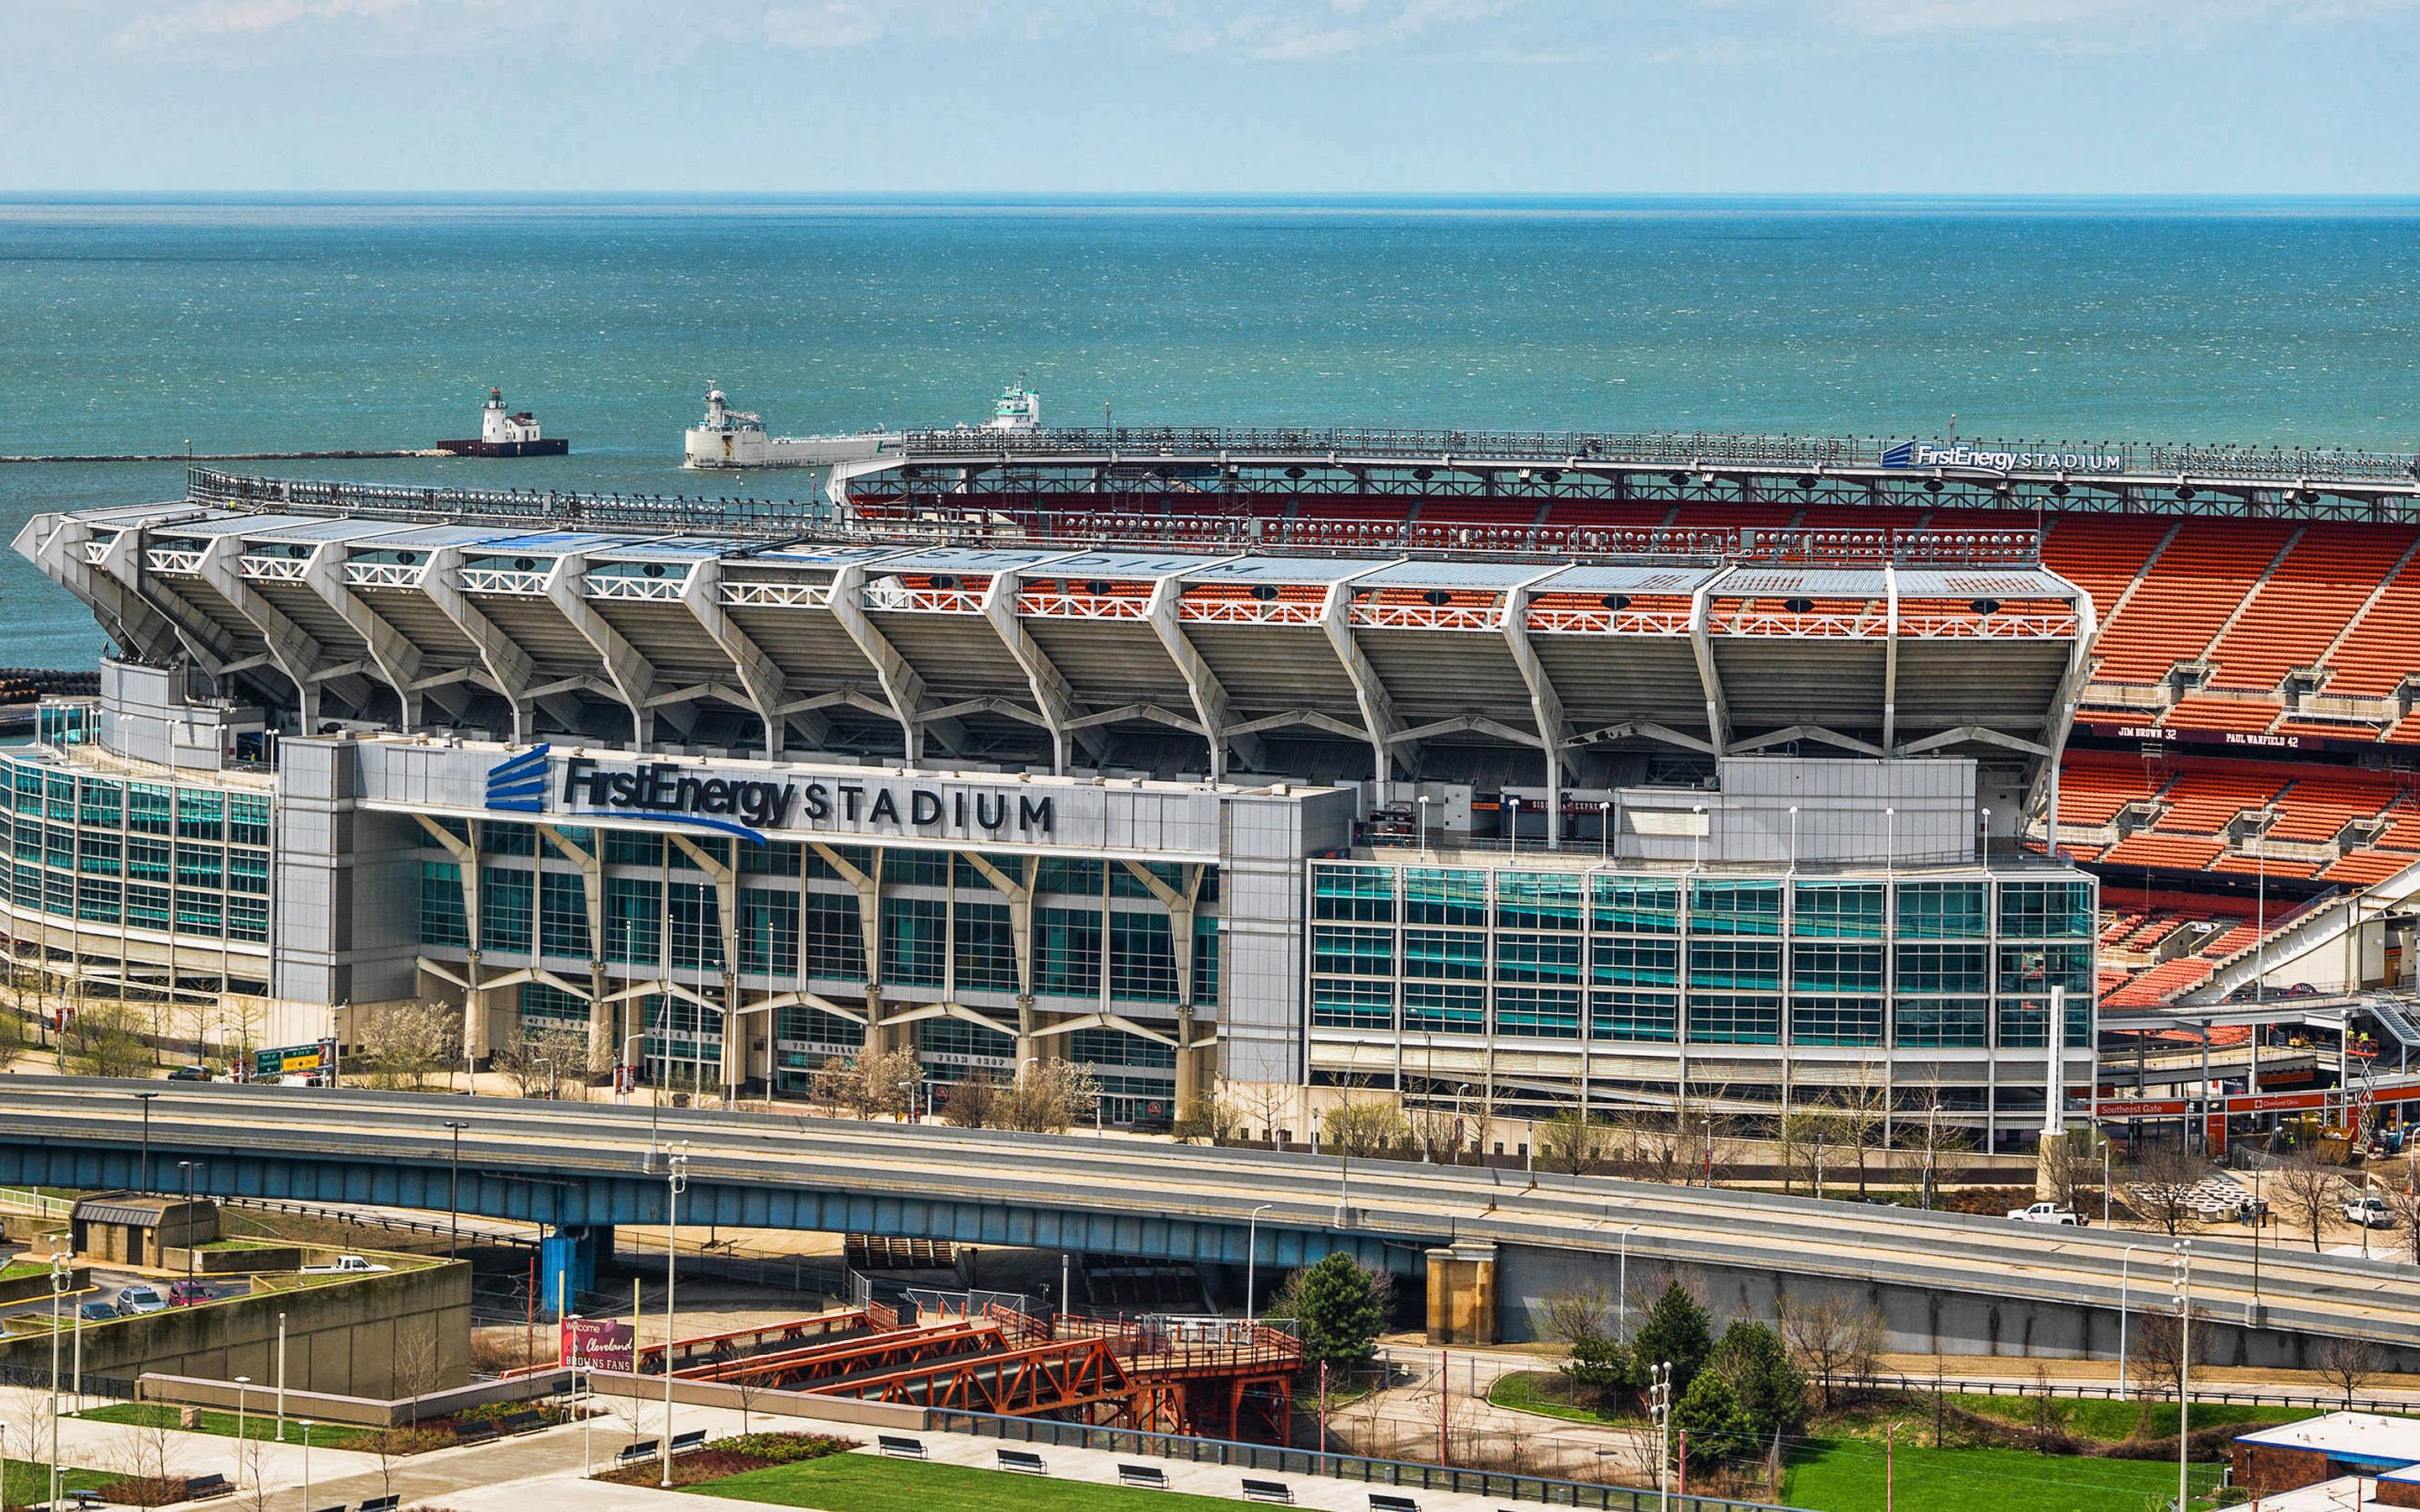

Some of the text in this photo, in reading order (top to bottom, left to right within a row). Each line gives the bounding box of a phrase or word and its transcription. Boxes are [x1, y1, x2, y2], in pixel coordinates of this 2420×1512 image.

[1918, 445, 2121, 470] FirstEnergy STADIUM
[2118, 727, 2176, 739] JIM BROWN 32
[2227, 733, 2298, 748] PAUL WARFIELD 42
[564, 757, 1051, 832] FirstEnergy STADIUM
[2102, 1104, 2162, 1114] Southeast Gate
[565, 1321, 601, 1333] Wcome
[587, 1336, 633, 1352] Cleveland
[566, 1355, 630, 1371] BROWNS FANS
